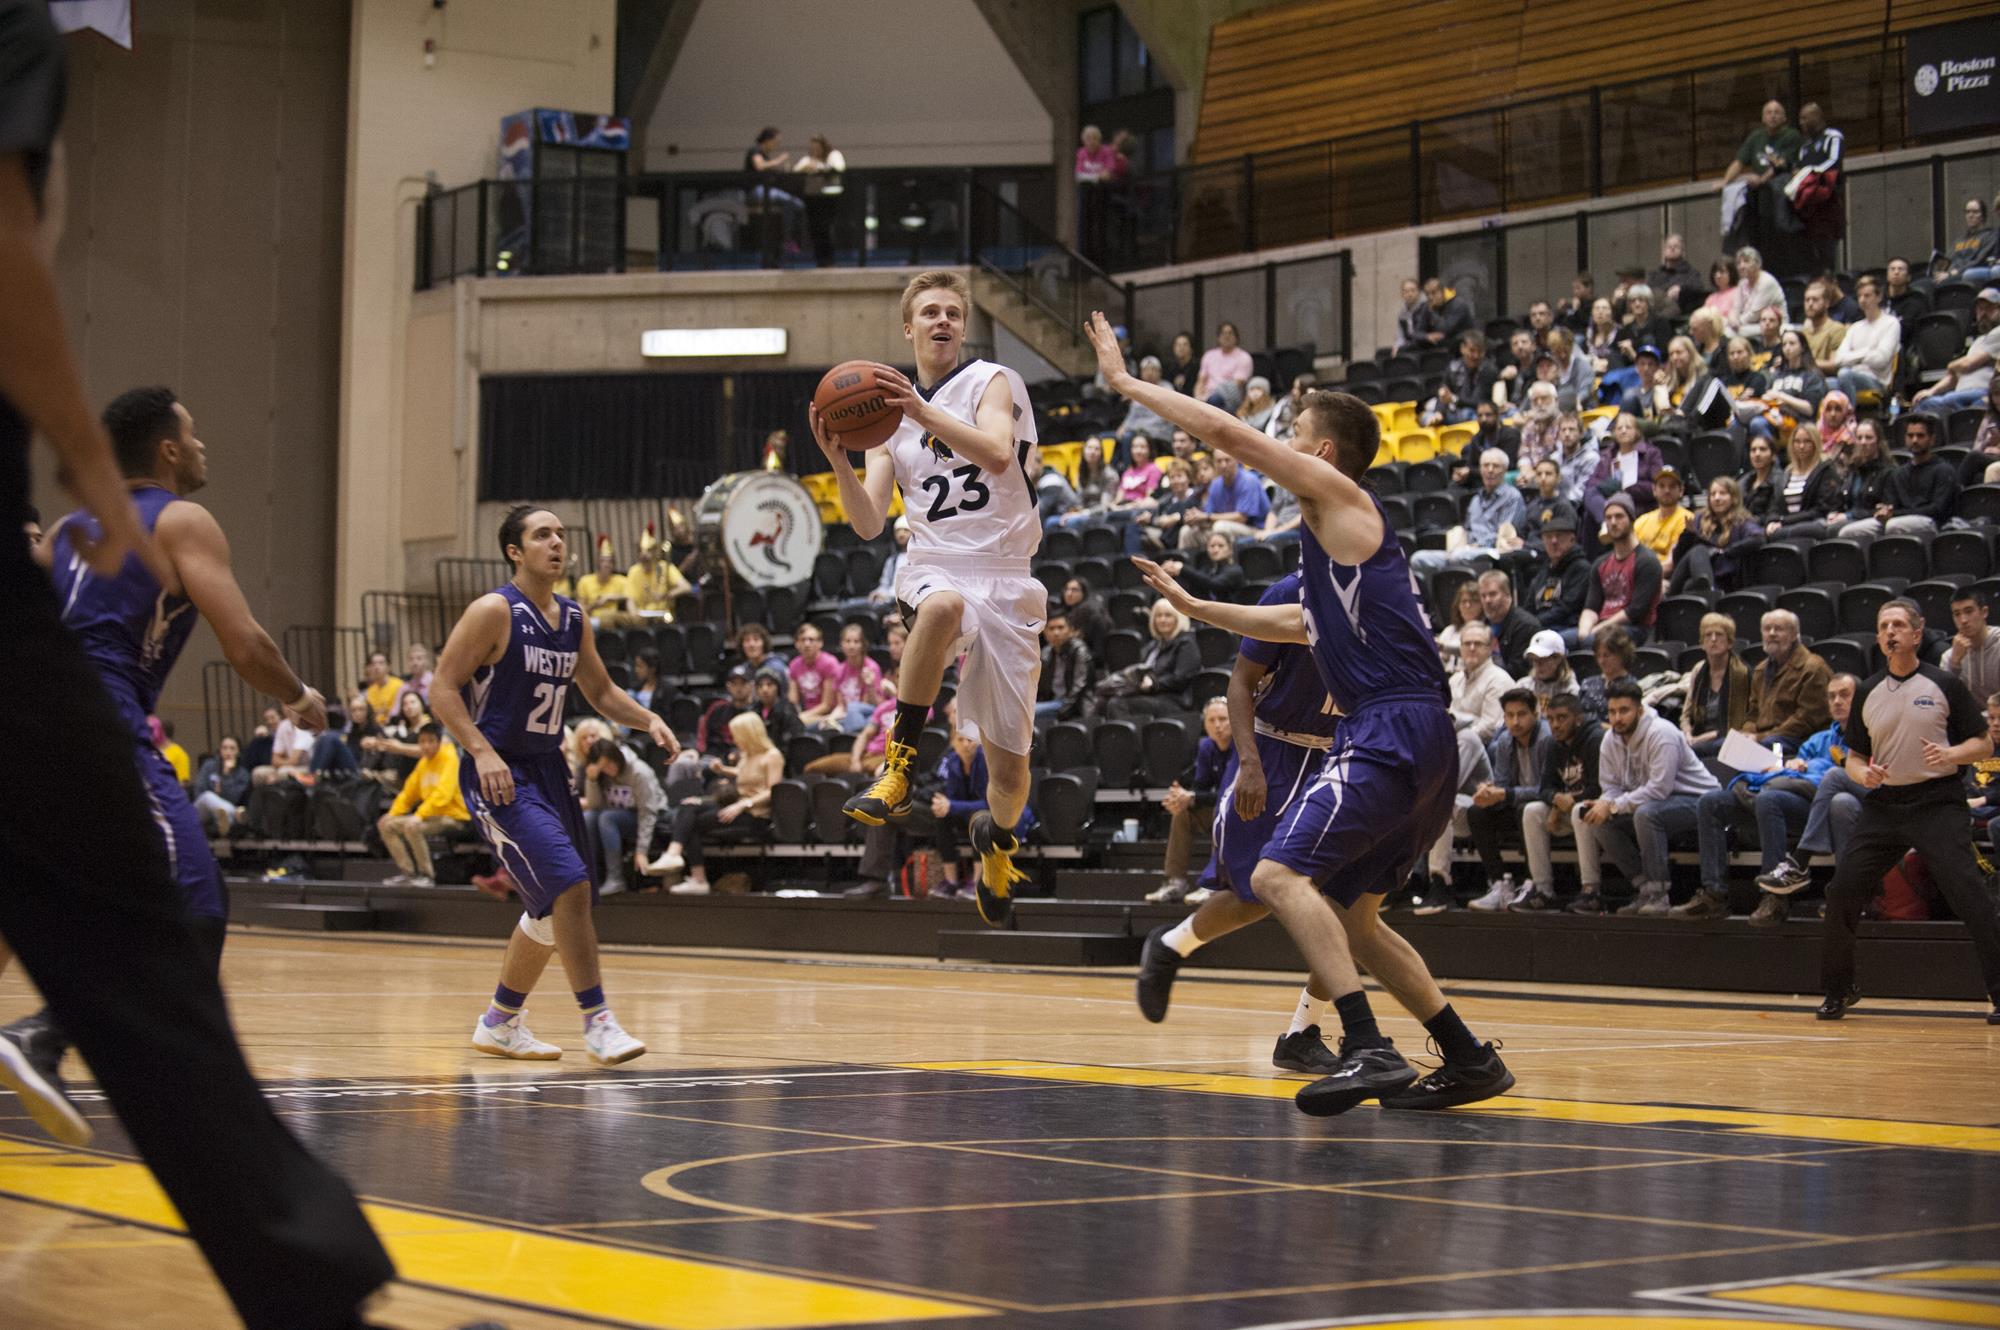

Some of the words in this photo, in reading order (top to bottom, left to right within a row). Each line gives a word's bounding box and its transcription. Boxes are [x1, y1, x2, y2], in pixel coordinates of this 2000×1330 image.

[1940, 57, 1996, 76] Boston
[1947, 74, 1990, 92] Pizza
[828, 395, 889, 420] Wilson
[922, 463, 991, 523] 23
